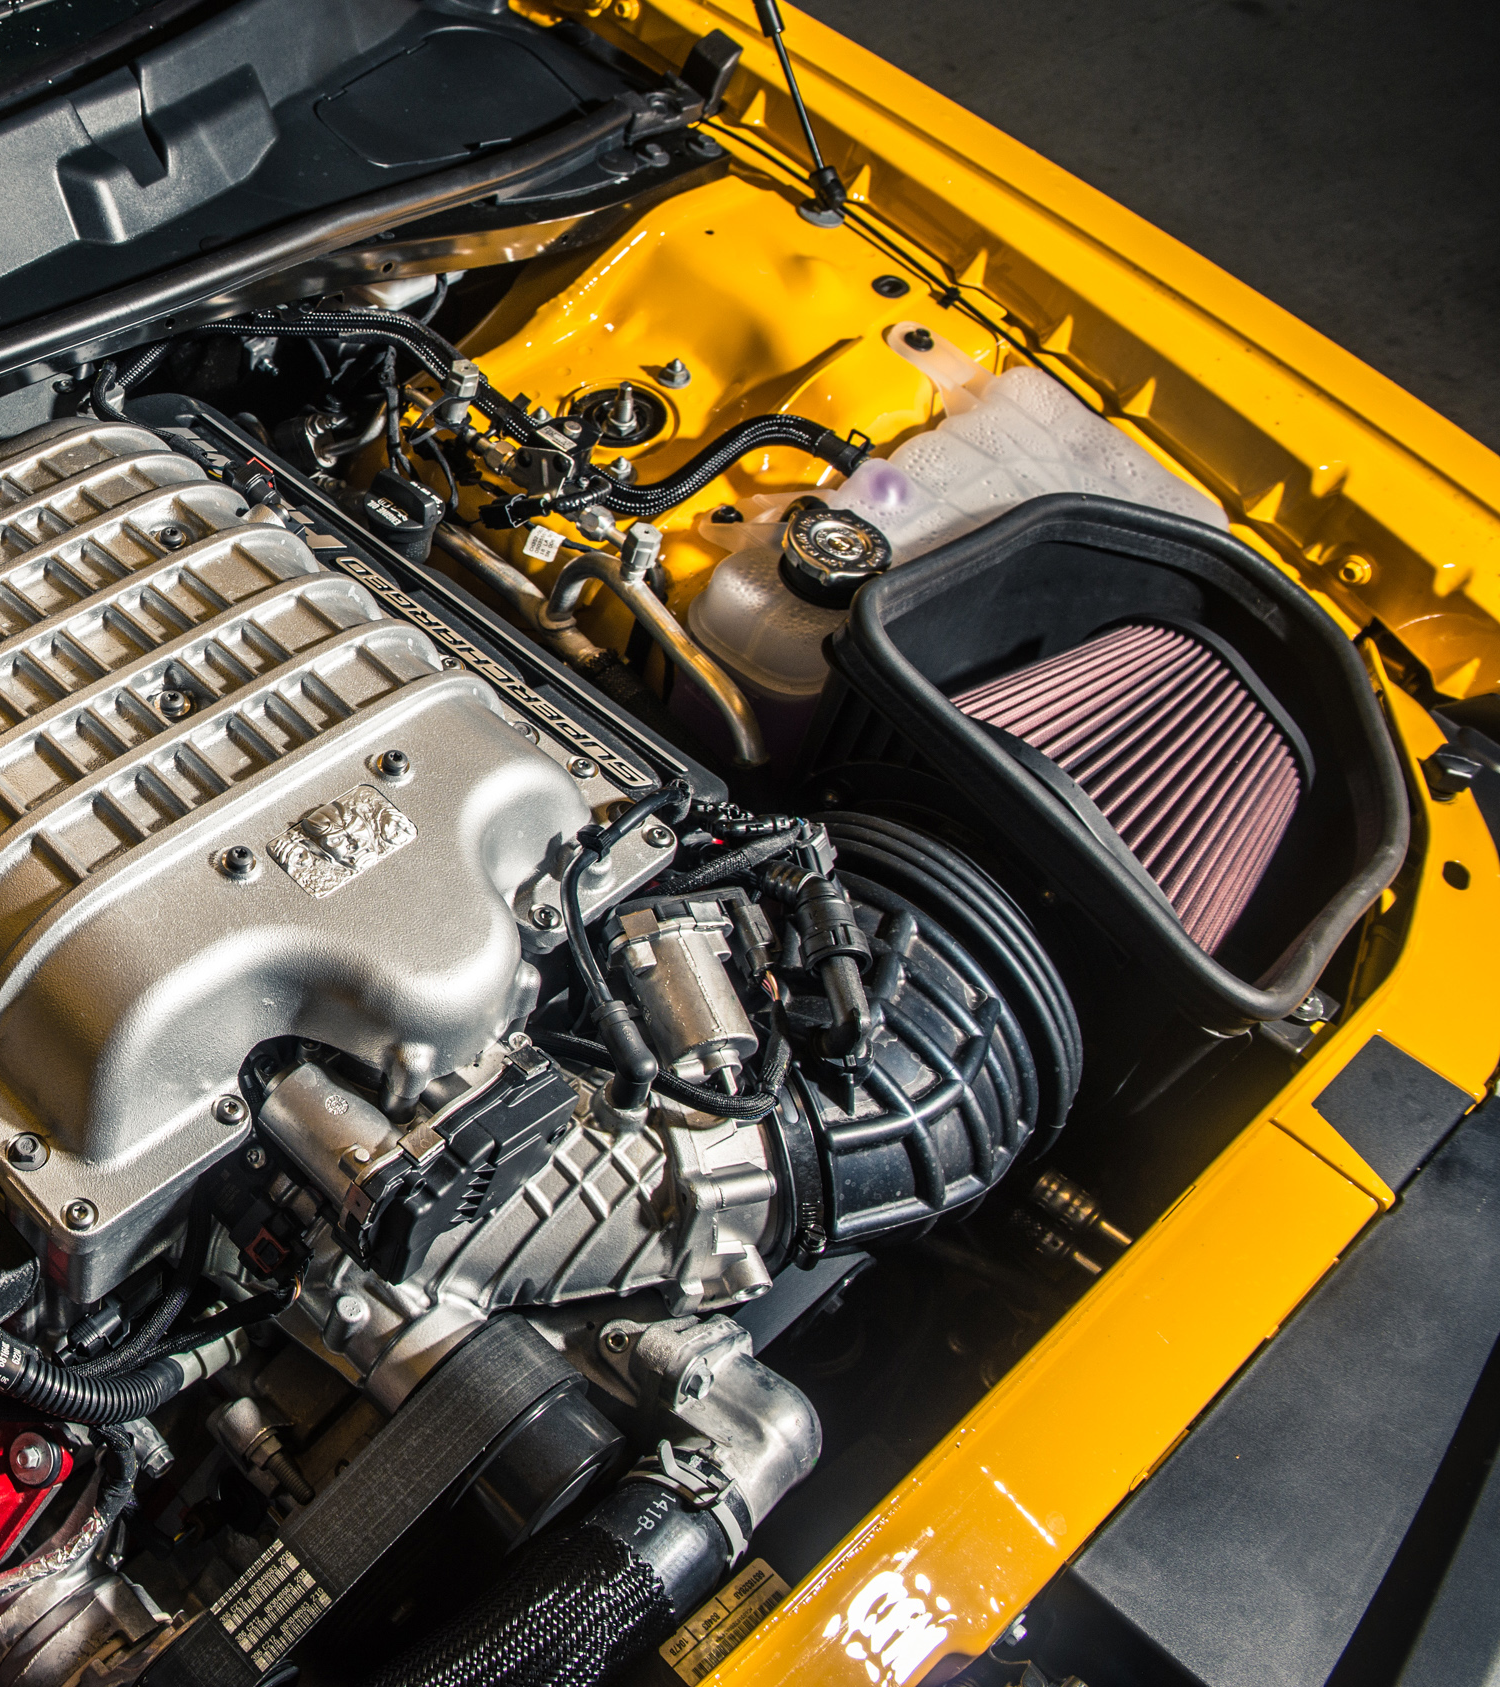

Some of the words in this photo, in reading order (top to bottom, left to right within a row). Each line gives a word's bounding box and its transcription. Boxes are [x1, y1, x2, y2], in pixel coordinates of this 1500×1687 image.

[367, 500, 380, 510] OIL
[376, 507, 402, 526] ENGINE
[343, 559, 647, 784] SUPERCHARGED
[230, 1597, 245, 1612] C212
[277, 1550, 293, 1565] 206
[245, 1616, 261, 1632] C212
[293, 1568, 308, 1584] 208
[251, 1648, 263, 1662] 306
[261, 1634, 277, 1651] C212
[309, 1587, 325, 1602] 210
